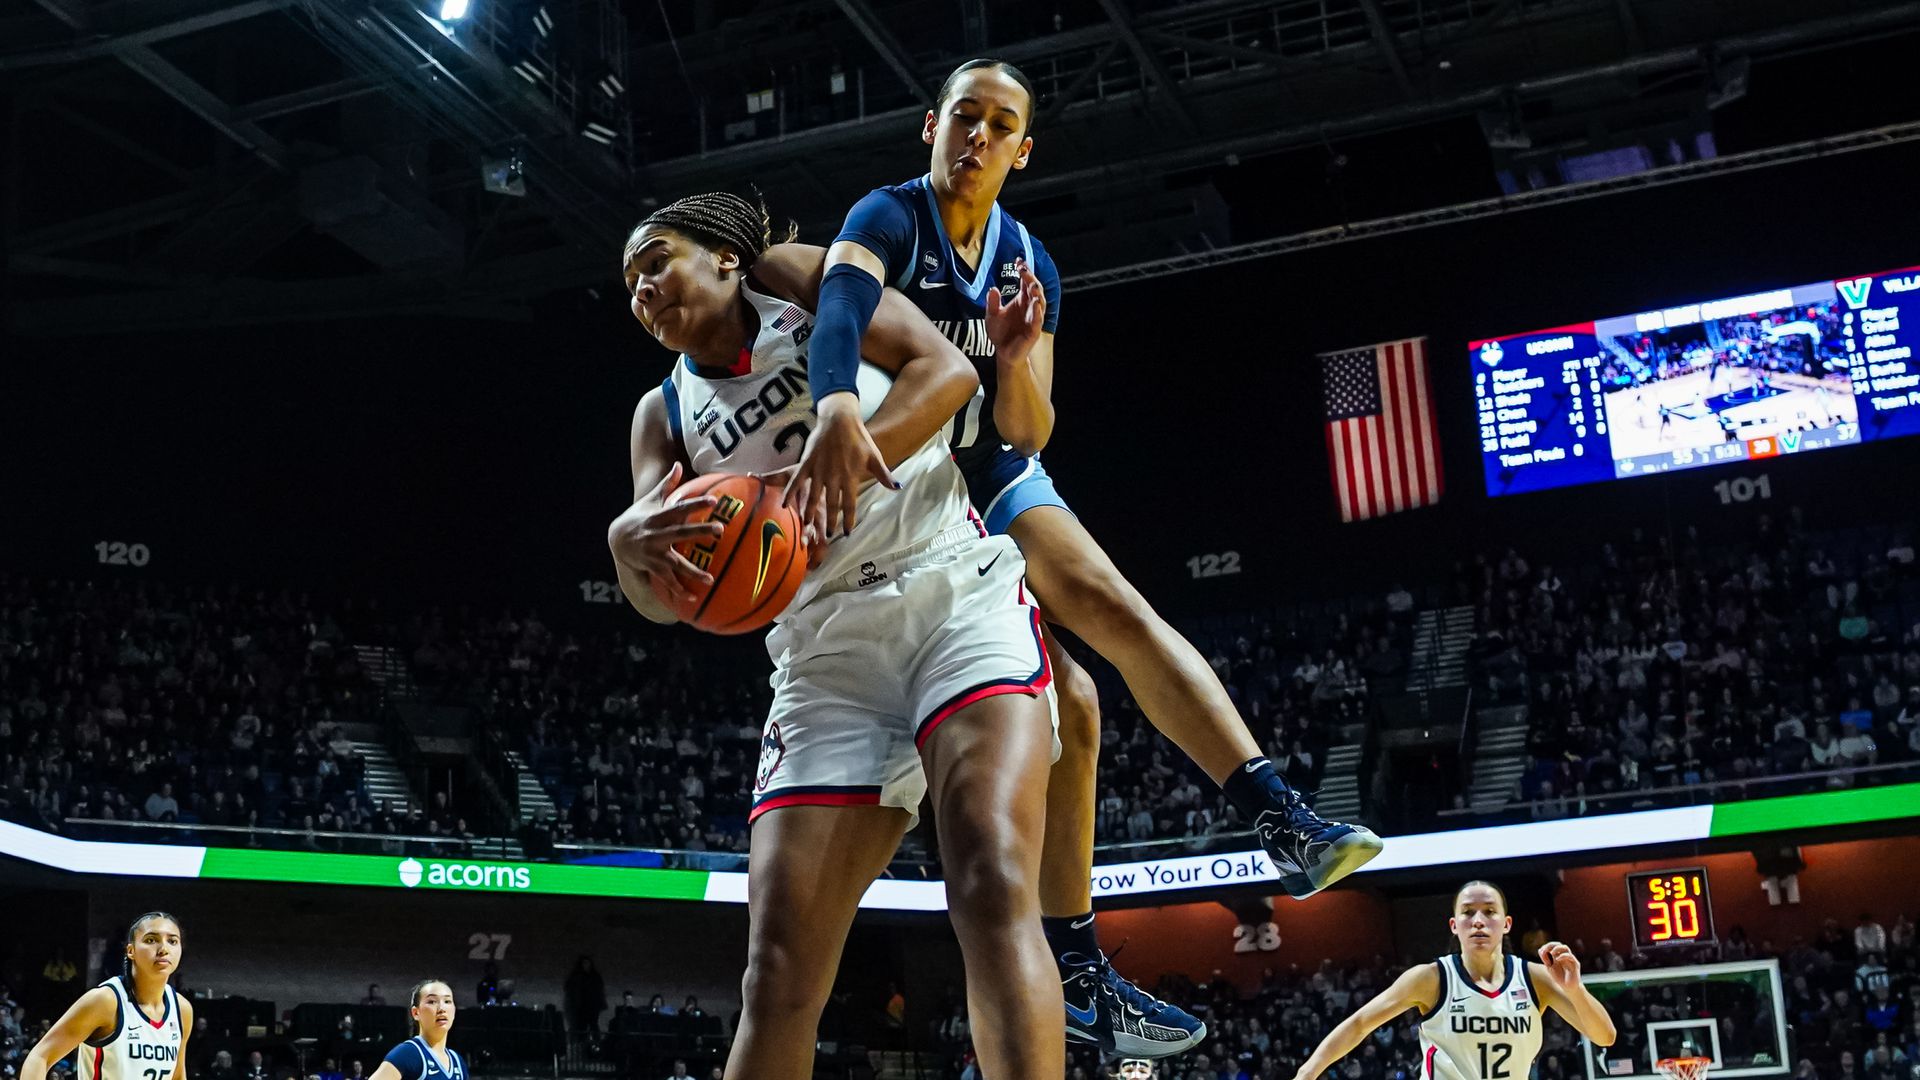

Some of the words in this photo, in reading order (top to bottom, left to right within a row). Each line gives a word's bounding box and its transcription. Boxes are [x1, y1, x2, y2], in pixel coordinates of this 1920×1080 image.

[709, 352, 809, 459] UCON
[1714, 474, 1771, 504] 101
[95, 541, 150, 567] 120
[1186, 551, 1241, 579] 122
[579, 580, 623, 603] 121
[858, 572, 888, 588] UCONN
[427, 863, 531, 888] acorns
[1090, 873, 1135, 890] row
[1144, 865, 1202, 885] Your
[1211, 855, 1265, 879] Oak
[1649, 876, 1701, 901] 5:31
[1760, 874, 1801, 906] 11
[1648, 899, 1700, 940] 30
[468, 933, 512, 960] 27
[1233, 922, 1281, 953] 28
[1451, 1015, 1531, 1034] UCONN
[1477, 1042, 1512, 1080] 12
